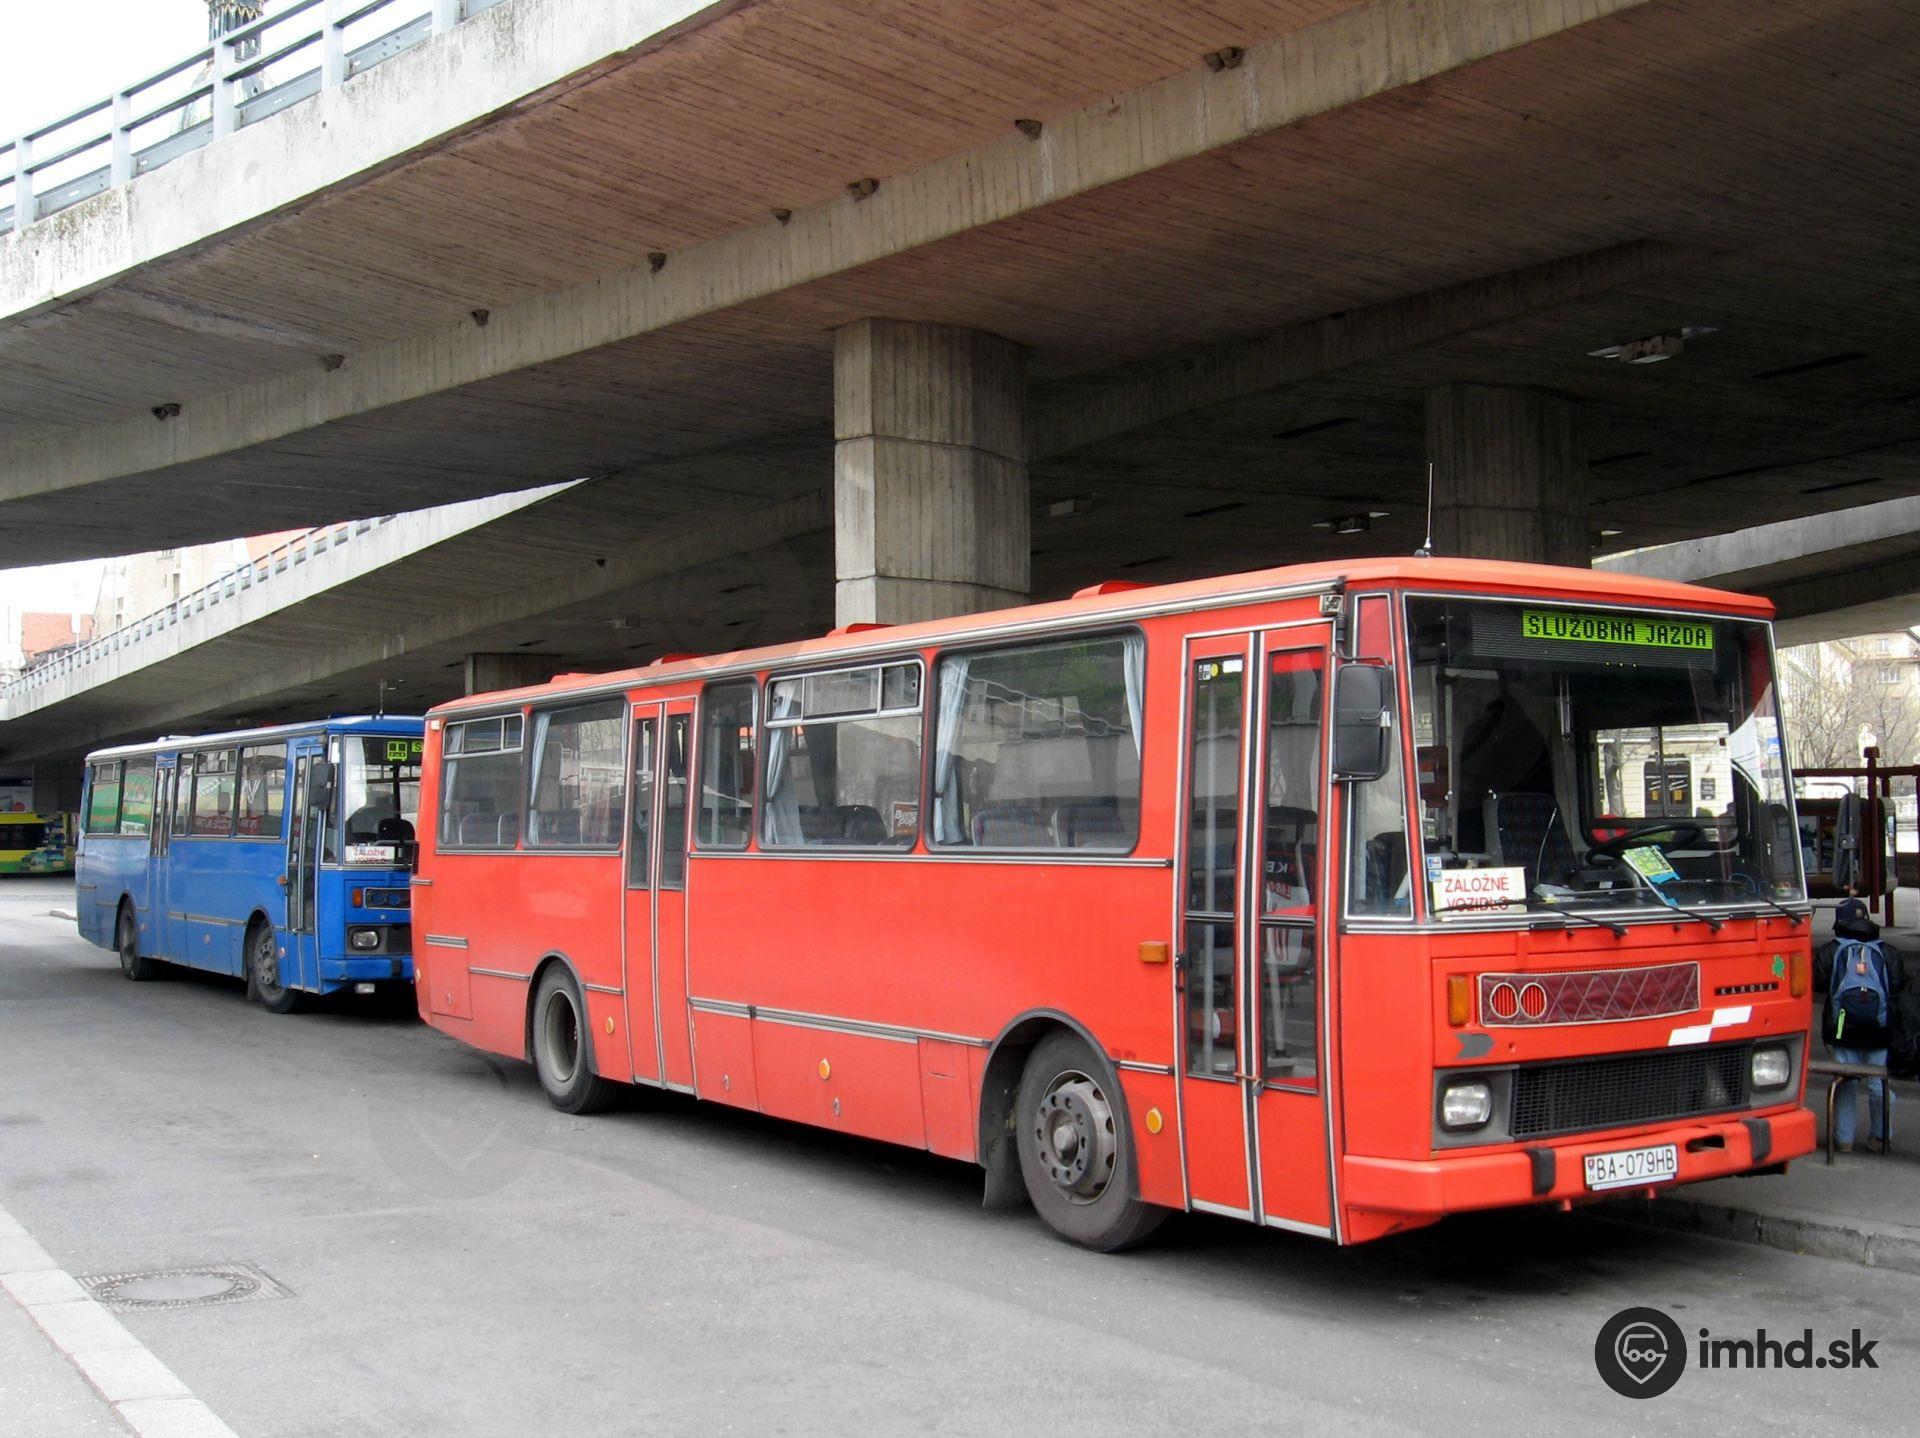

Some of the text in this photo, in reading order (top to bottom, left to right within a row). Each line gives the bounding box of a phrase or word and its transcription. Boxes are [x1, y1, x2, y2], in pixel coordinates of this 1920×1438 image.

[1528, 613, 1707, 647] SLUŽOBNÁ JAZDA
[1444, 872, 1510, 893] ZÁLOŽNÉ
[1720, 983, 1773, 995] KAROSA
[1597, 1149, 1675, 1180] BA-079HB
